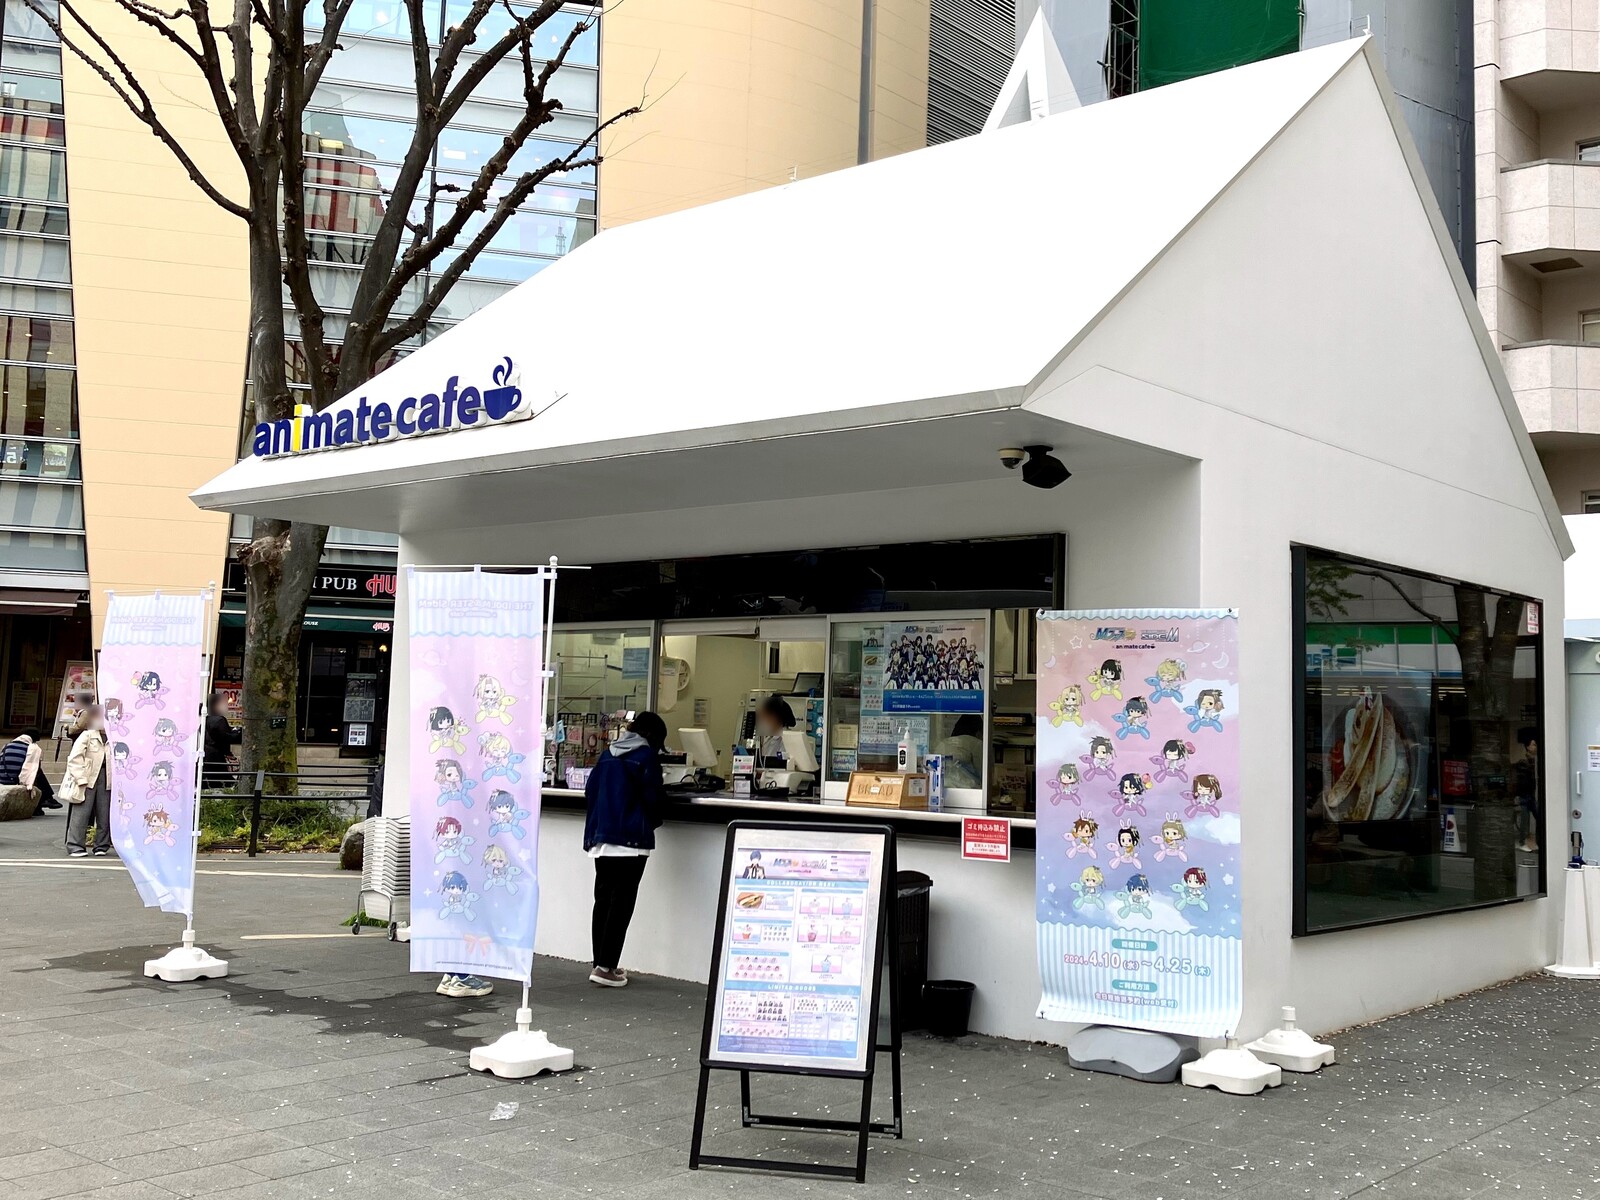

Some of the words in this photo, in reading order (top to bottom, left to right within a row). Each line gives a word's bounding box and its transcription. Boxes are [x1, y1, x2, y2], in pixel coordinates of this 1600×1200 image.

[252, 396, 393, 456] animate
[396, 375, 482, 435] cafe
[321, 576, 358, 591] PUB
[365, 573, 397, 598] HU
[857, 783, 894, 797] BRAD
